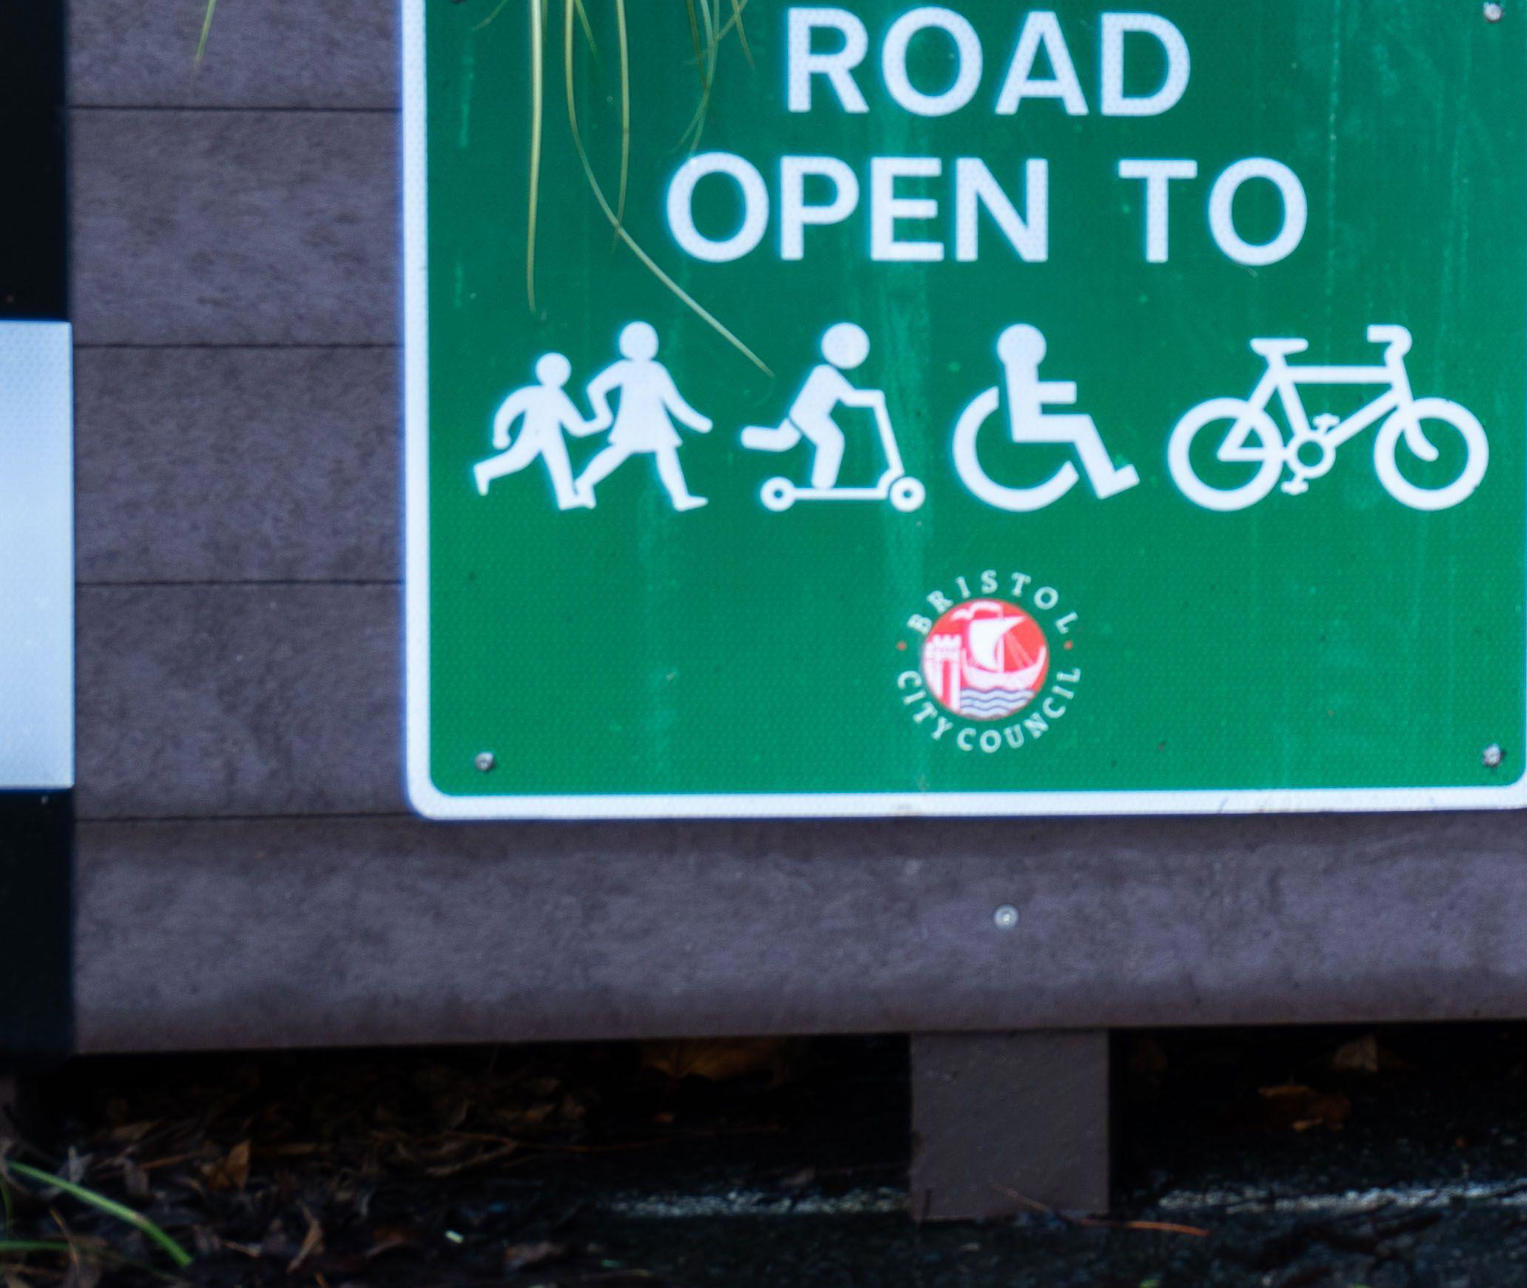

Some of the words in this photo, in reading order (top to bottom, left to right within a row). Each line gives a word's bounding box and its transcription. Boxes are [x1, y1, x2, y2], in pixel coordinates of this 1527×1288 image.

[787, 7, 1191, 116] ROAD
[666, 152, 1049, 263] OPEN
[1118, 157, 1308, 265] TO
[907, 569, 1078, 635] BRISTOL
[897, 670, 953, 741] CITY
[956, 668, 1081, 753] COUNCIL
